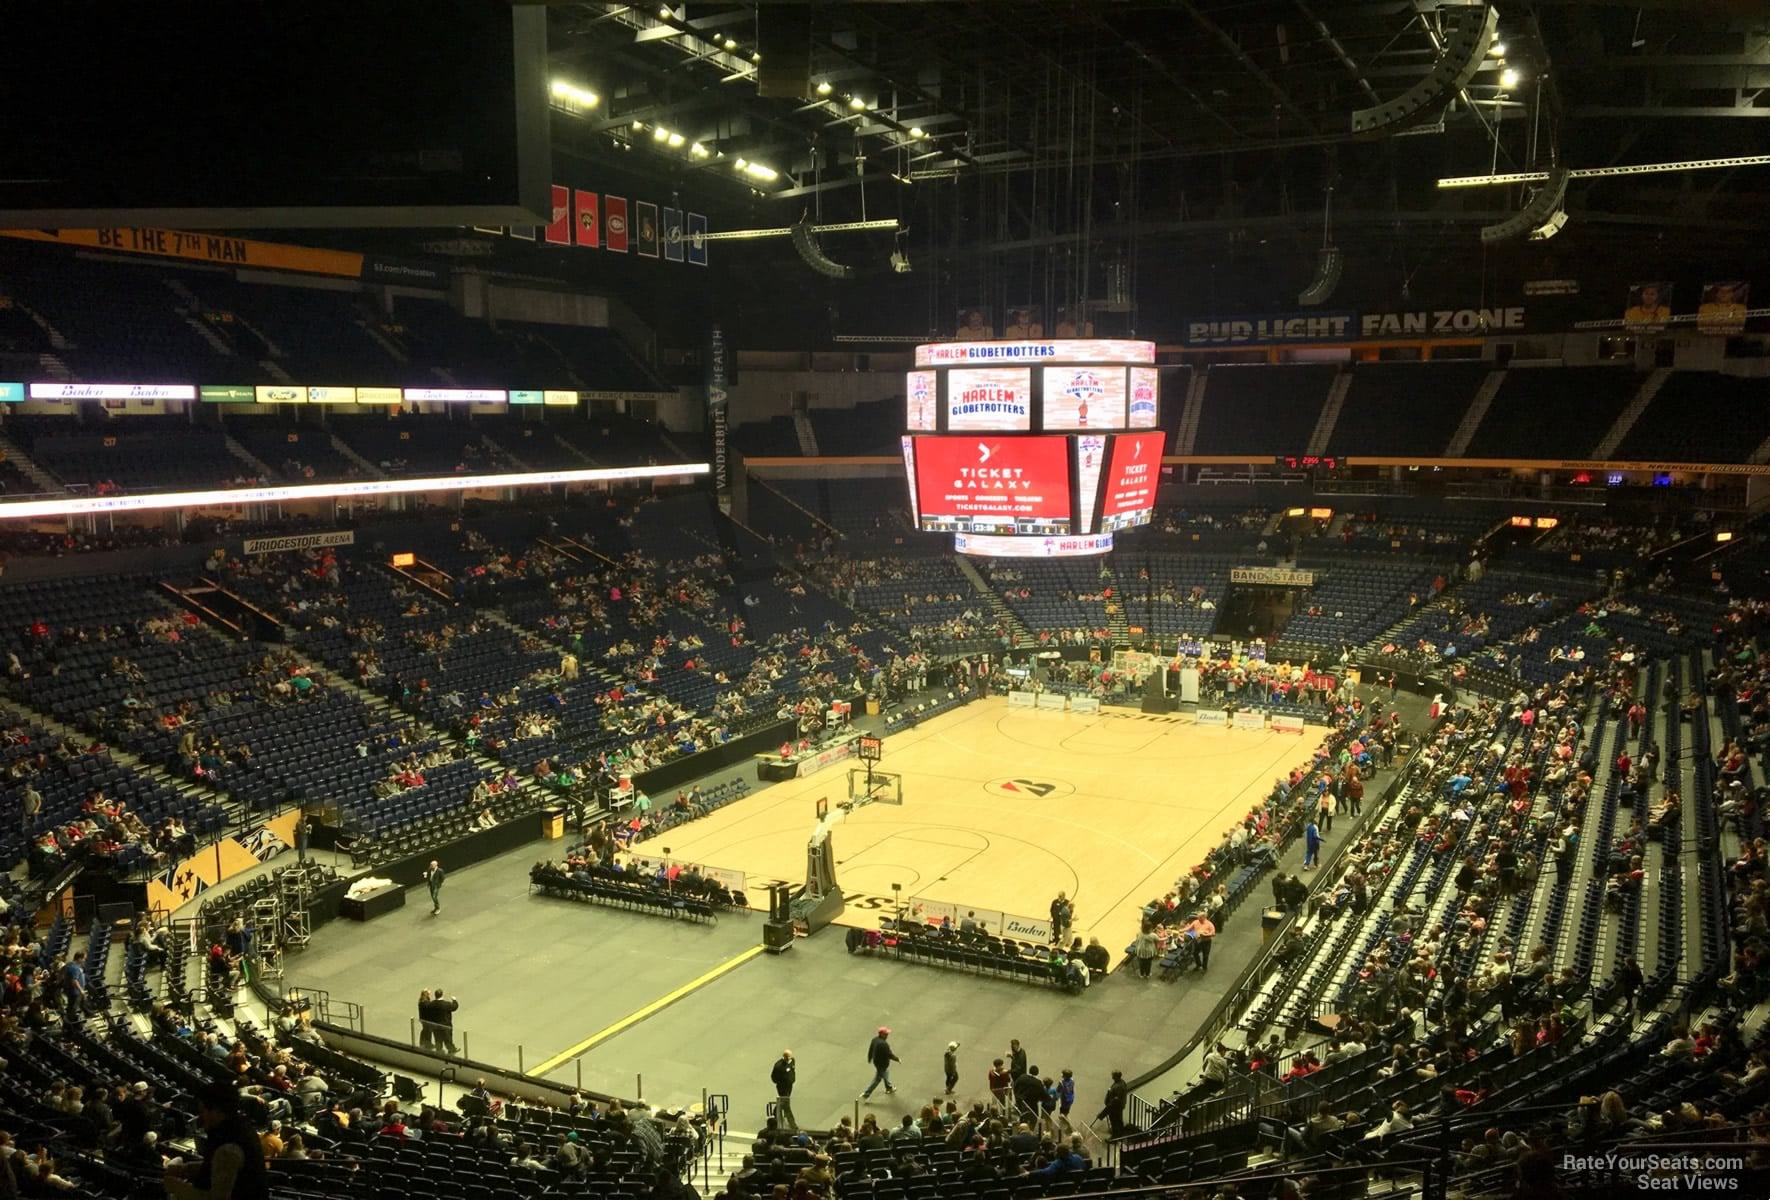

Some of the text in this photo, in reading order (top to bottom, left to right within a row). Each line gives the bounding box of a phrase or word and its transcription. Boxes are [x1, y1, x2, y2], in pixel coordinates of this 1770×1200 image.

[98, 228, 247, 262] BE THE 7TH MAN
[1189, 308, 1525, 343] BUD LIGHT FAN ZONE
[935, 346, 1055, 359] HARLEM GLOBETROTTERS
[61, 385, 169, 397] Baden Baden
[962, 389, 1015, 403] HARLEM
[712, 330, 727, 489] VANDERBILT HEALTH
[952, 403, 1026, 416] GLOBETROTTERS
[960, 468, 1024, 478] TICKET
[1125, 464, 1148, 475] TICKET
[954, 480, 1031, 489] GALAXY
[1120, 476, 1148, 487] GALAXY
[956, 503, 1033, 512] TICKETGALAXY.COM
[249, 534, 350, 552] BRIDGESTONE ARENA
[1060, 540, 1094, 551] HARLEM
[1233, 571, 1312, 582] BAND STAGE
[1007, 921, 1047, 938] Baden
